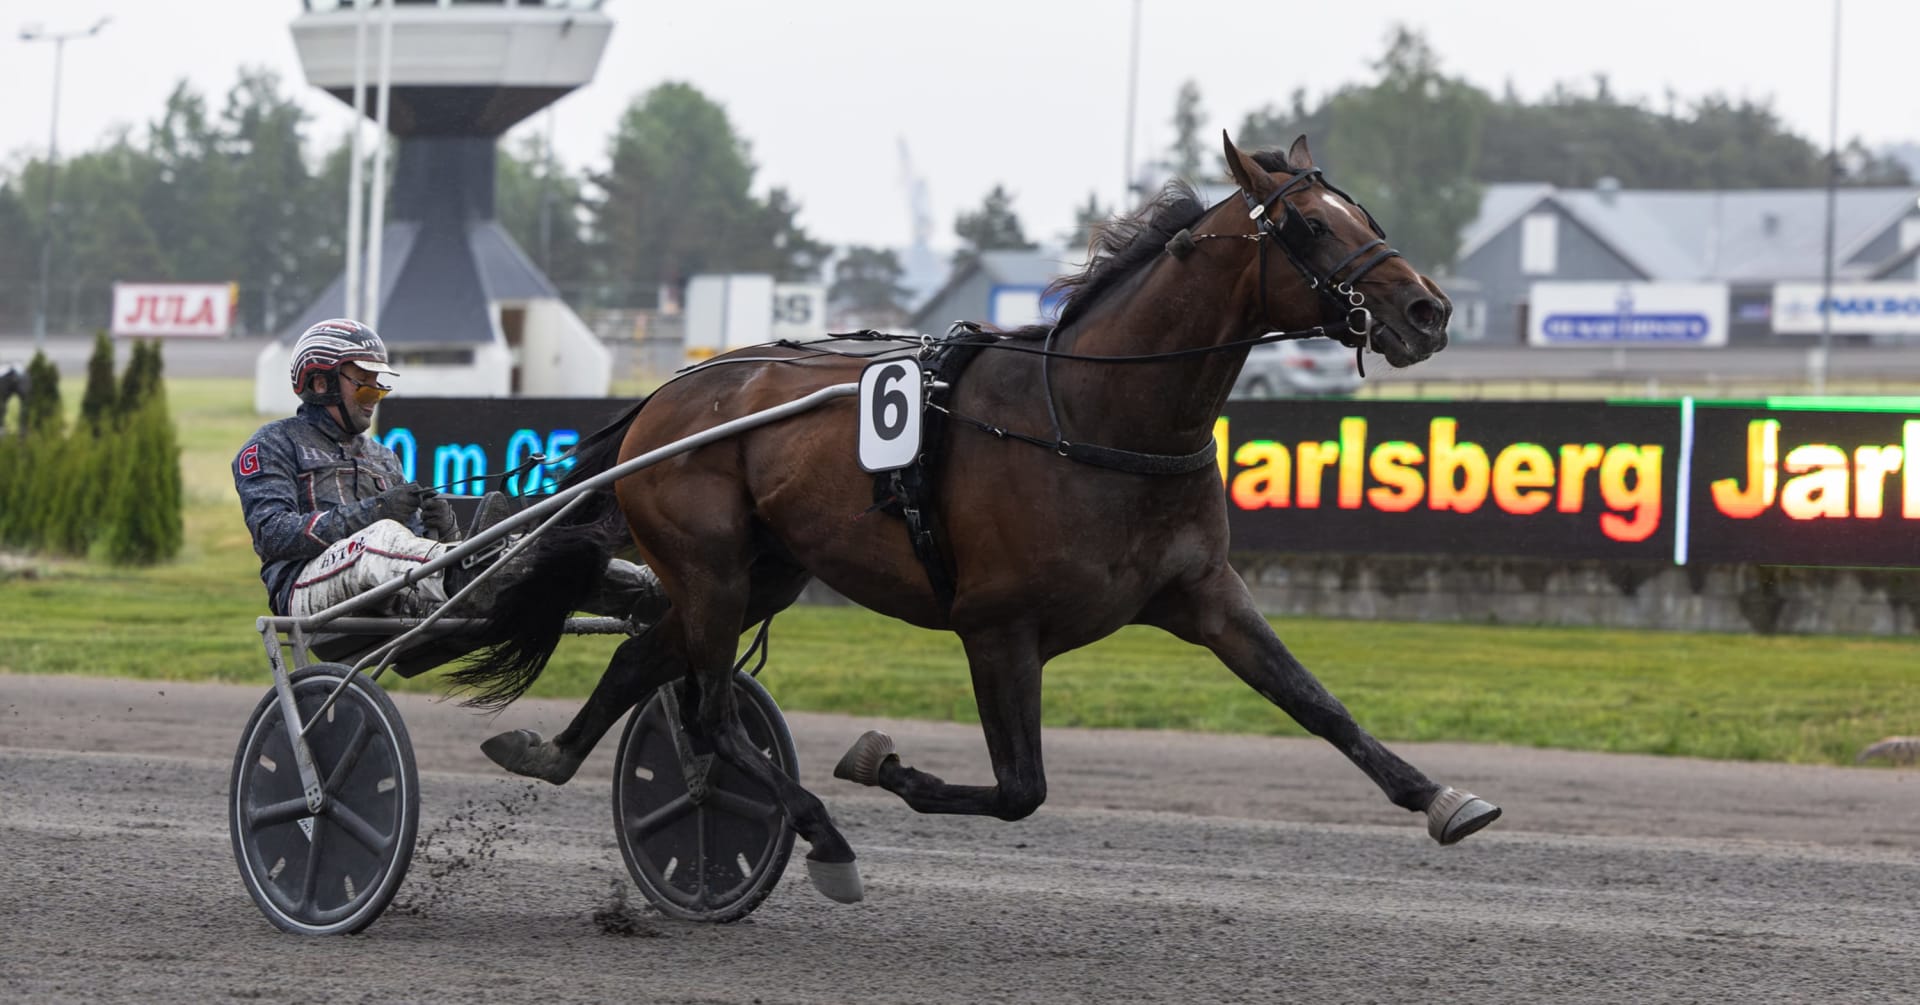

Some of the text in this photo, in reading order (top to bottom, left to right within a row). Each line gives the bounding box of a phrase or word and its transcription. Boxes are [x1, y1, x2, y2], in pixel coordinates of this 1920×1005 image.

[125, 295, 215, 325] JULA
[872, 364, 908, 441] 6
[239, 443, 261, 476] G
[374, 427, 580, 497] 0 m 05
